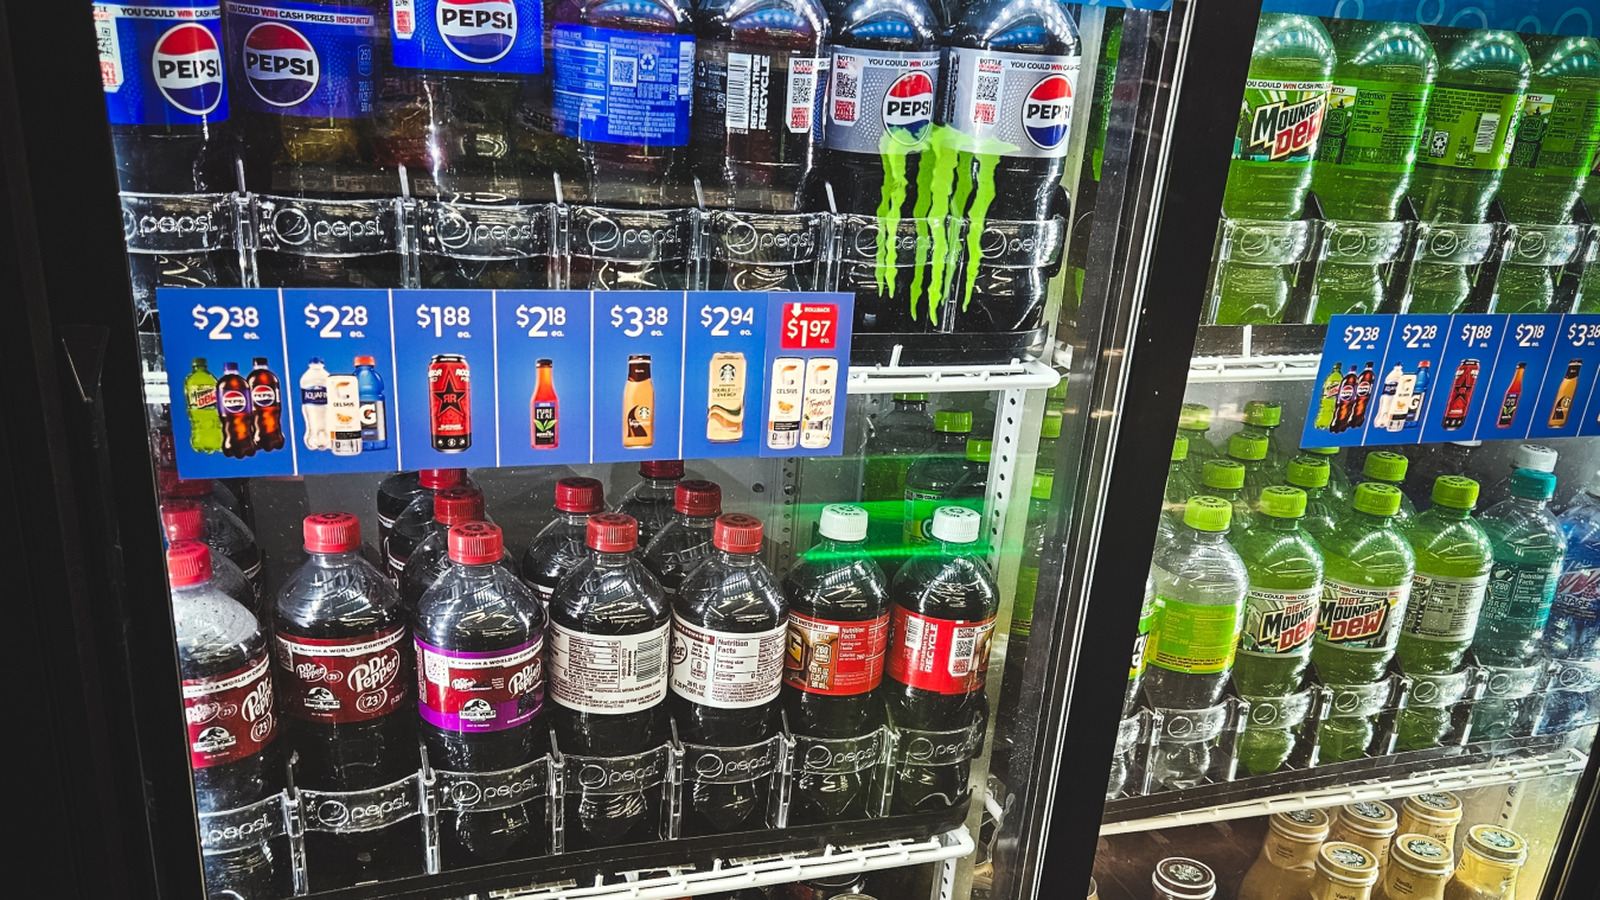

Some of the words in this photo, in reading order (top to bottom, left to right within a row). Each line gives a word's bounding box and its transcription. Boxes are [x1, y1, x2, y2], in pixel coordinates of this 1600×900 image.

[120, 8, 140, 16] YOU
[143, 9, 175, 17] COULD
[238, 5, 260, 15] COULD
[261, 8, 278, 17] WIN
[280, 10, 304, 20] CASH
[305, 13, 335, 23] PRIZES
[442, 9, 513, 30] PEPSI
[158, 59, 220, 78] PEPSI
[246, 52, 314, 76] PEPSI
[1027, 62, 1050, 70] COULD
[758, 55, 771, 130] RECYCLE
[1359, 91, 1386, 100] Nutrition
[887, 101, 931, 116] PEPSI
[140, 213, 213, 237] pepsi
[313, 216, 381, 241] pepsi
[474, 222, 535, 246] pepsi
[622, 224, 679, 247] pepsi
[893, 235, 938, 251] peps
[243, 331, 260, 340] ea.
[349, 330, 365, 338] ea.
[651, 329, 664, 337] ea.
[740, 328, 752, 336] ea.
[1324, 580, 1338, 588] OULD
[1285, 602, 1305, 616] DIET
[1338, 597, 1360, 606] DIET
[1555, 593, 1593, 609] OLTAGE
[363, 639, 391, 650] CONTENT
[718, 639, 749, 647] Nutrition
[924, 624, 939, 673] RECYCLE
[368, 655, 388, 675] Dr
[489, 658, 512, 666] WORLD
[297, 665, 324, 679] Pepper
[348, 656, 397, 692] Pepper
[222, 676, 246, 687] WORLD
[365, 696, 378, 707] 23
[258, 722, 267, 735] 23
[725, 750, 771, 773] pepsi
[609, 762, 656, 785] pepsi
[484, 774, 535, 801] pepsi
[351, 793, 410, 822] pepsi
[208, 814, 272, 843] pepsi
